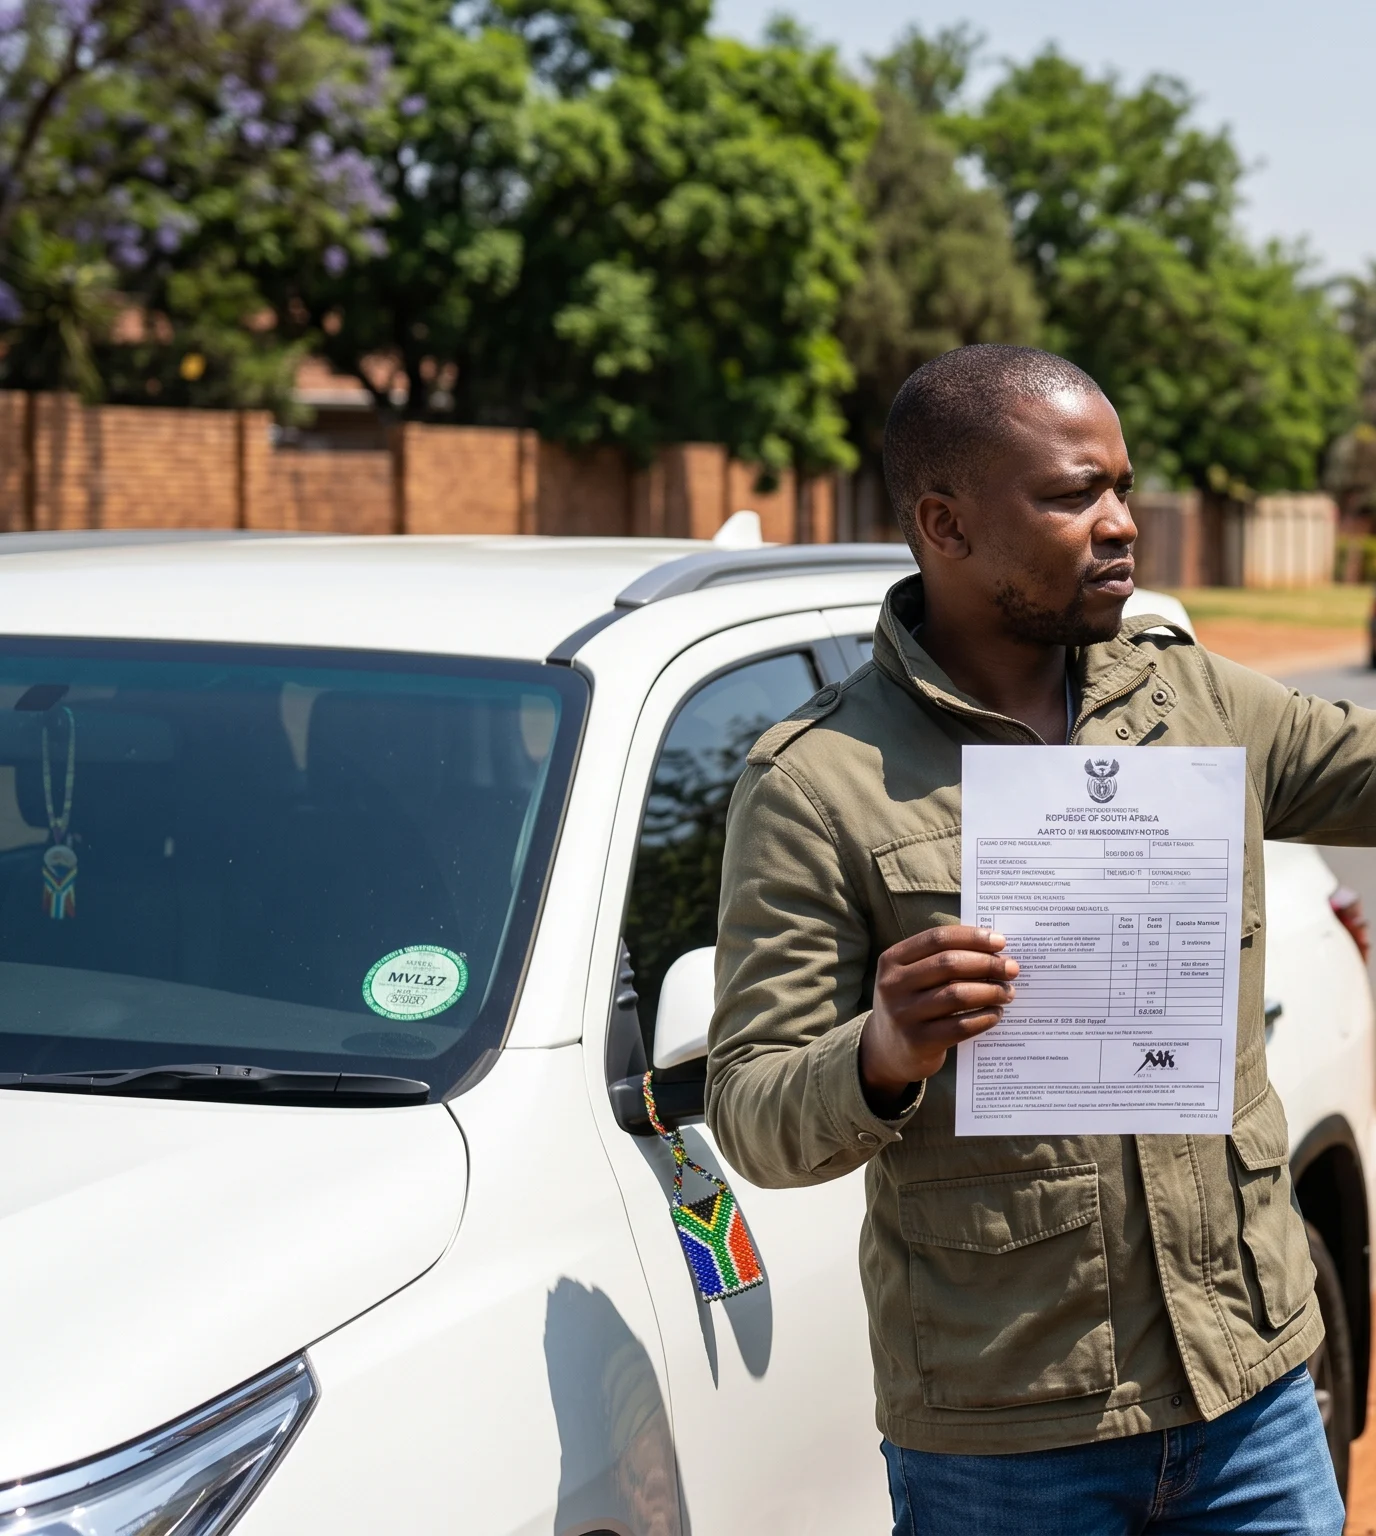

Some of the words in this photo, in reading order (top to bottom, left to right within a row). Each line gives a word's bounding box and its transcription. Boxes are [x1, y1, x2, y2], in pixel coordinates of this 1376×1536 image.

[1088, 814, 1099, 822] OF
[1100, 814, 1127, 822] SOUTH
[1037, 828, 1066, 836] AARTO
